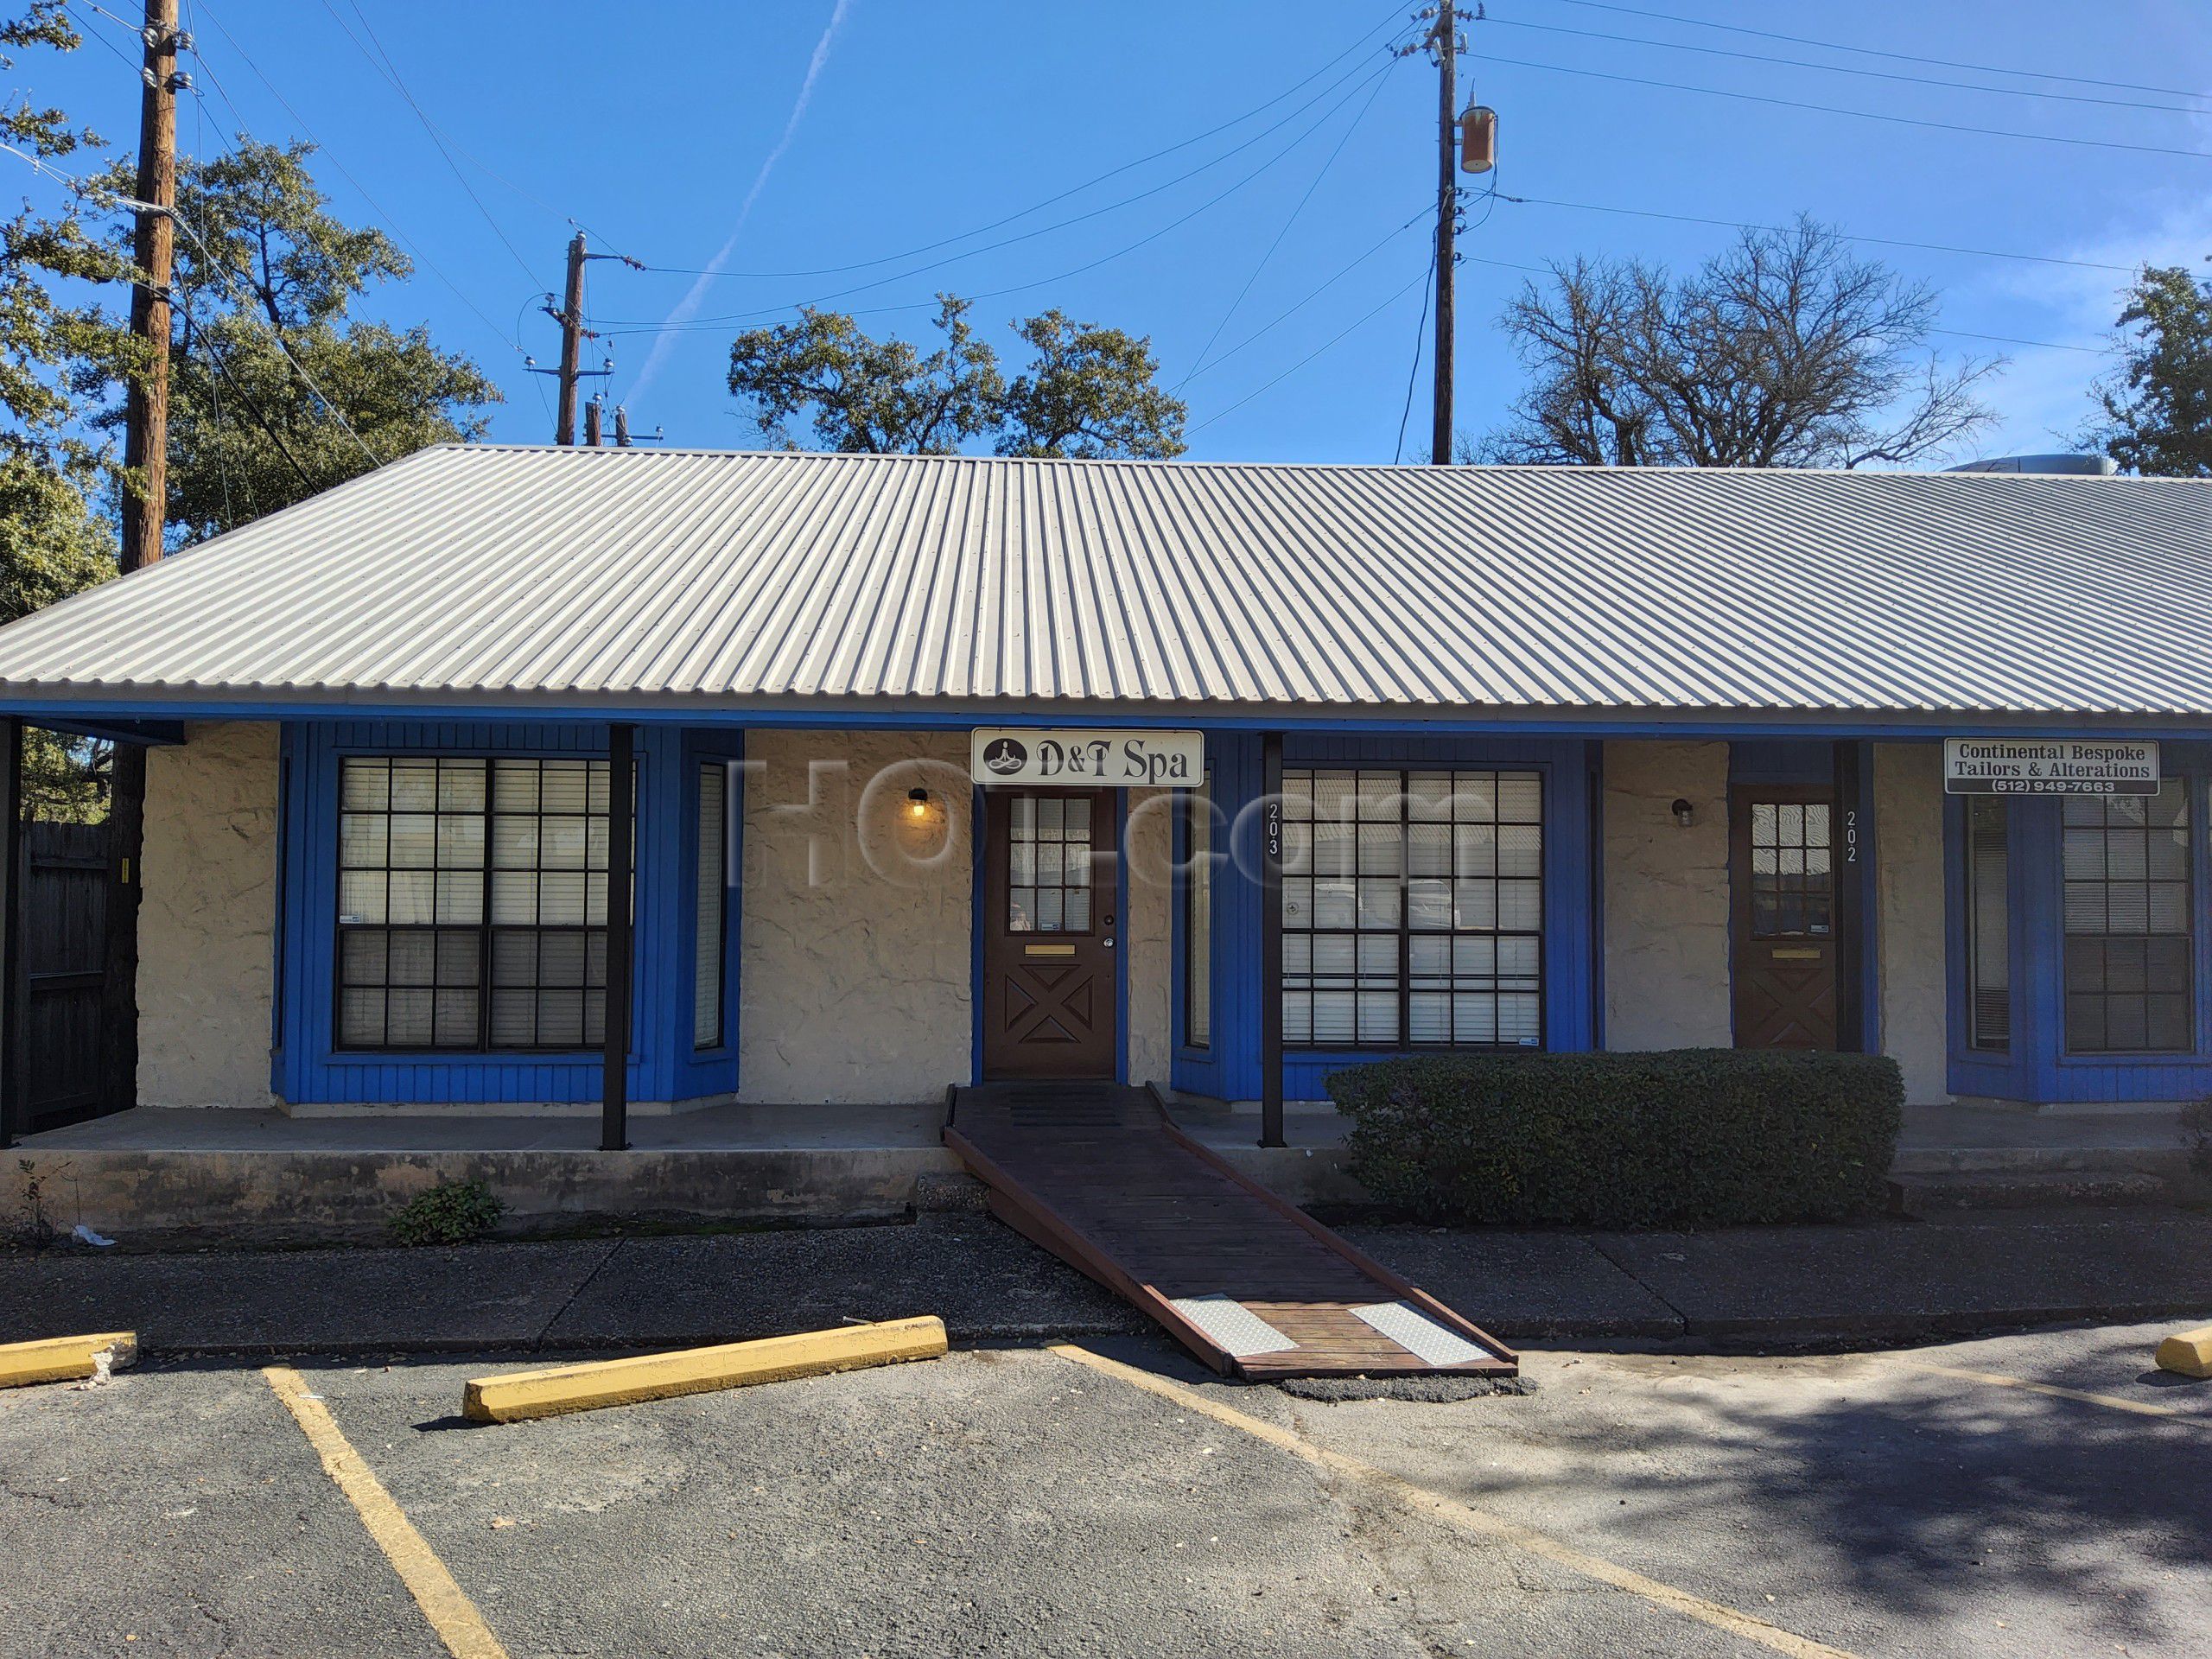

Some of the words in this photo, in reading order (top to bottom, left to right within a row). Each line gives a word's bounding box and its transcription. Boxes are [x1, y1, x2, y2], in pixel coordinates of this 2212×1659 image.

[1036, 739, 1112, 776] D&T
[1122, 739, 1188, 785] Spa
[1959, 743, 2064, 760] Continental
[2071, 745, 2145, 763] Bespoke
[1955, 761, 2021, 776] Tailors
[2028, 762, 2043, 776] &
[2050, 762, 2151, 779] Alterations
[1992, 779, 2031, 792] (512)
[2034, 780, 2115, 792] 949-7663
[1269, 804, 1278, 855] 203
[1847, 810, 1856, 862] 202
